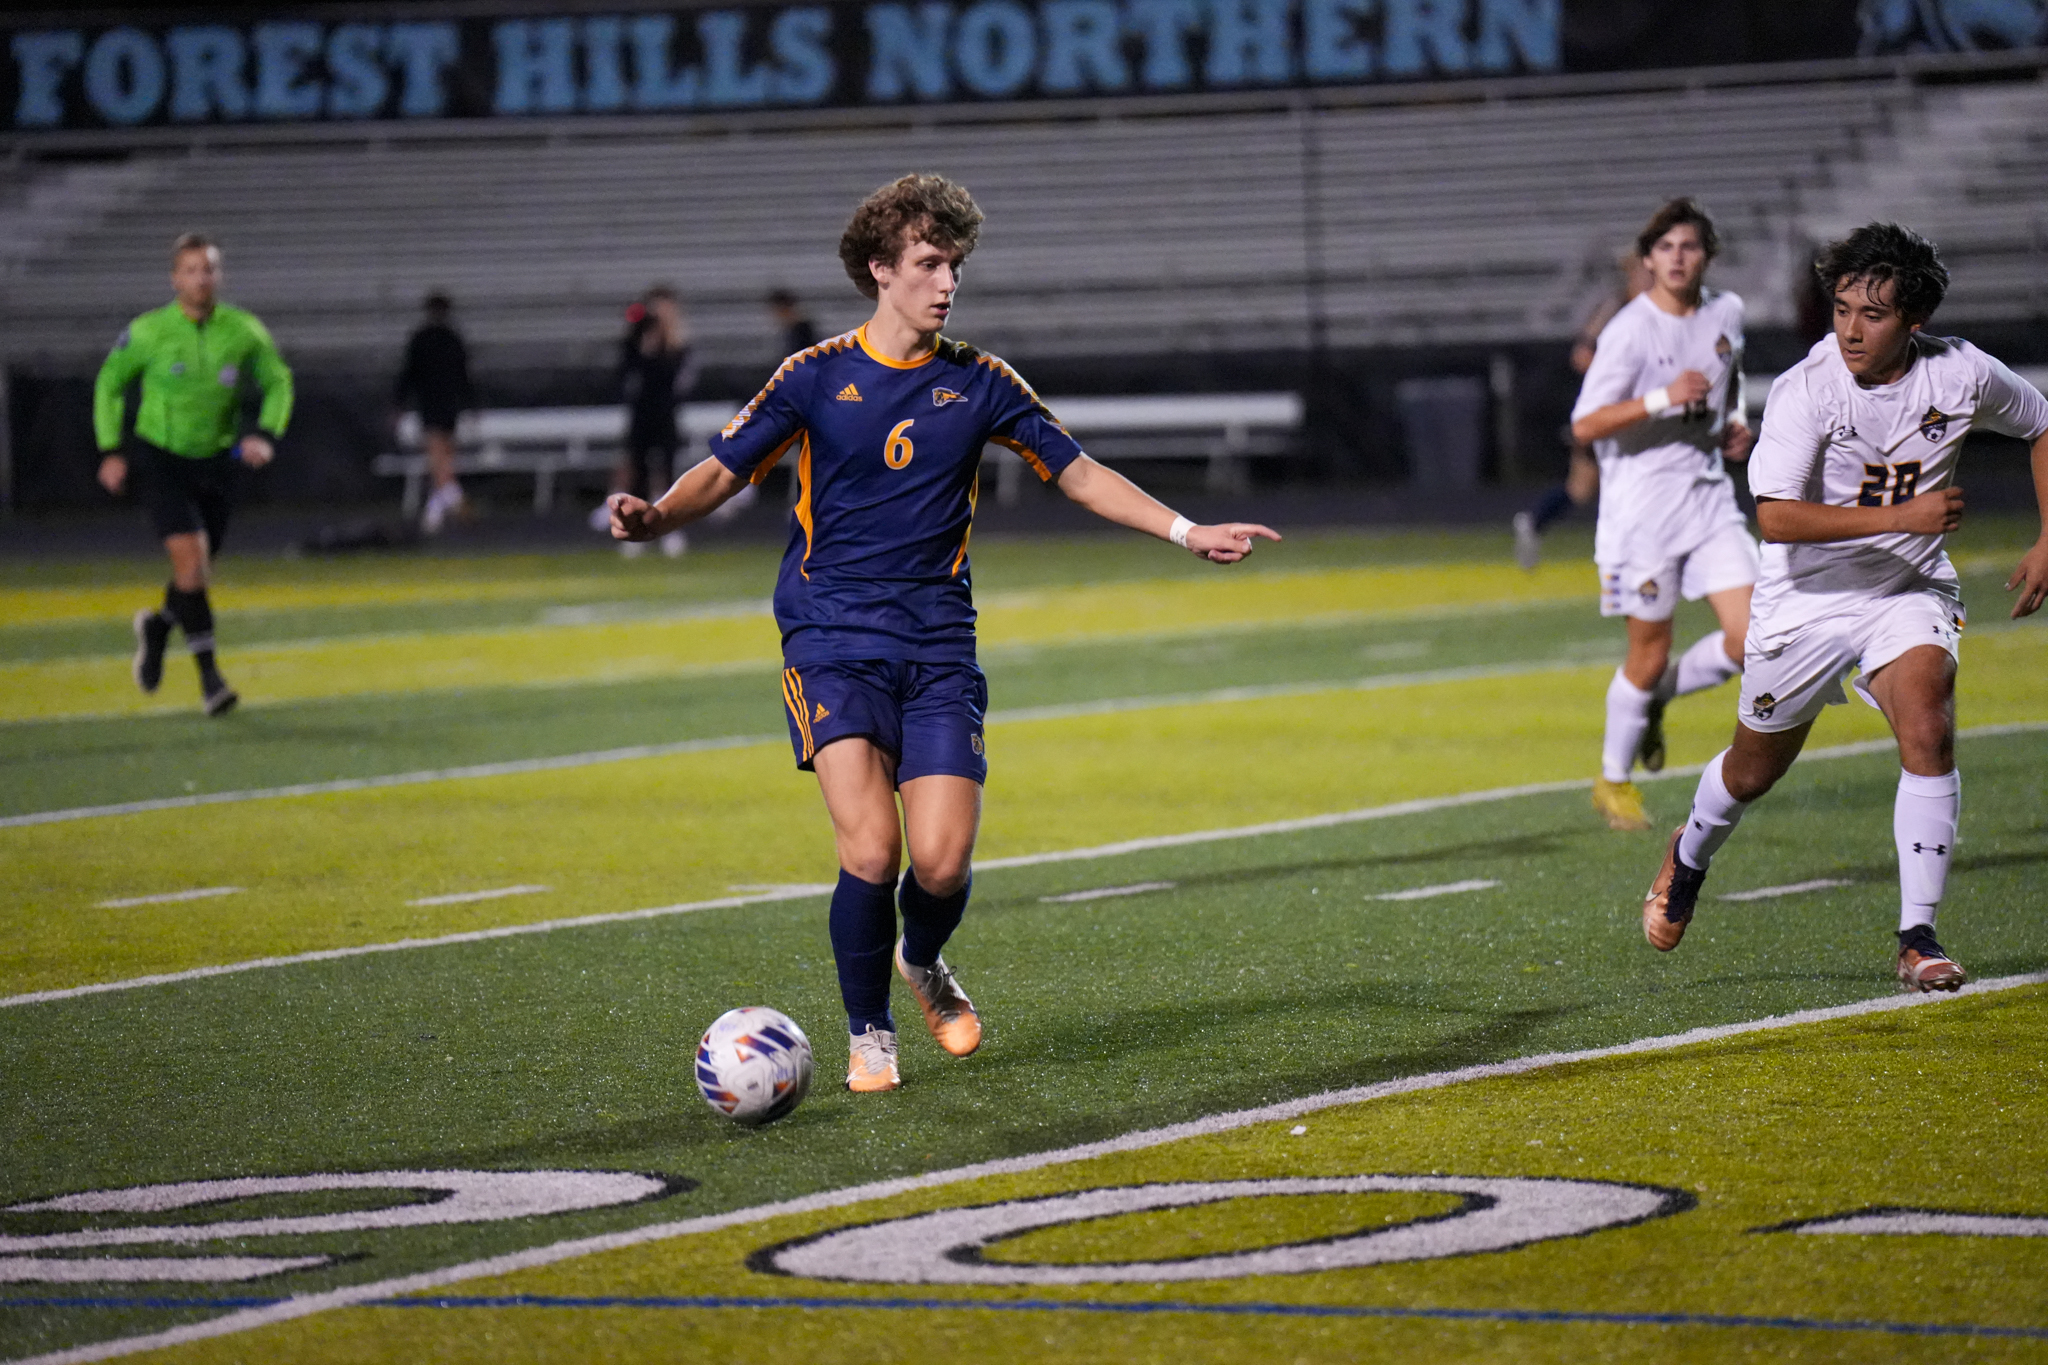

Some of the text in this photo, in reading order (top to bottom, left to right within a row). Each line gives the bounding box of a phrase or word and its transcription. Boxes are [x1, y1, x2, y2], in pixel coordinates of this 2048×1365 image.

[11, 0, 1563, 127] FOREST HILLS NORTHERN
[883, 418, 914, 470] 6
